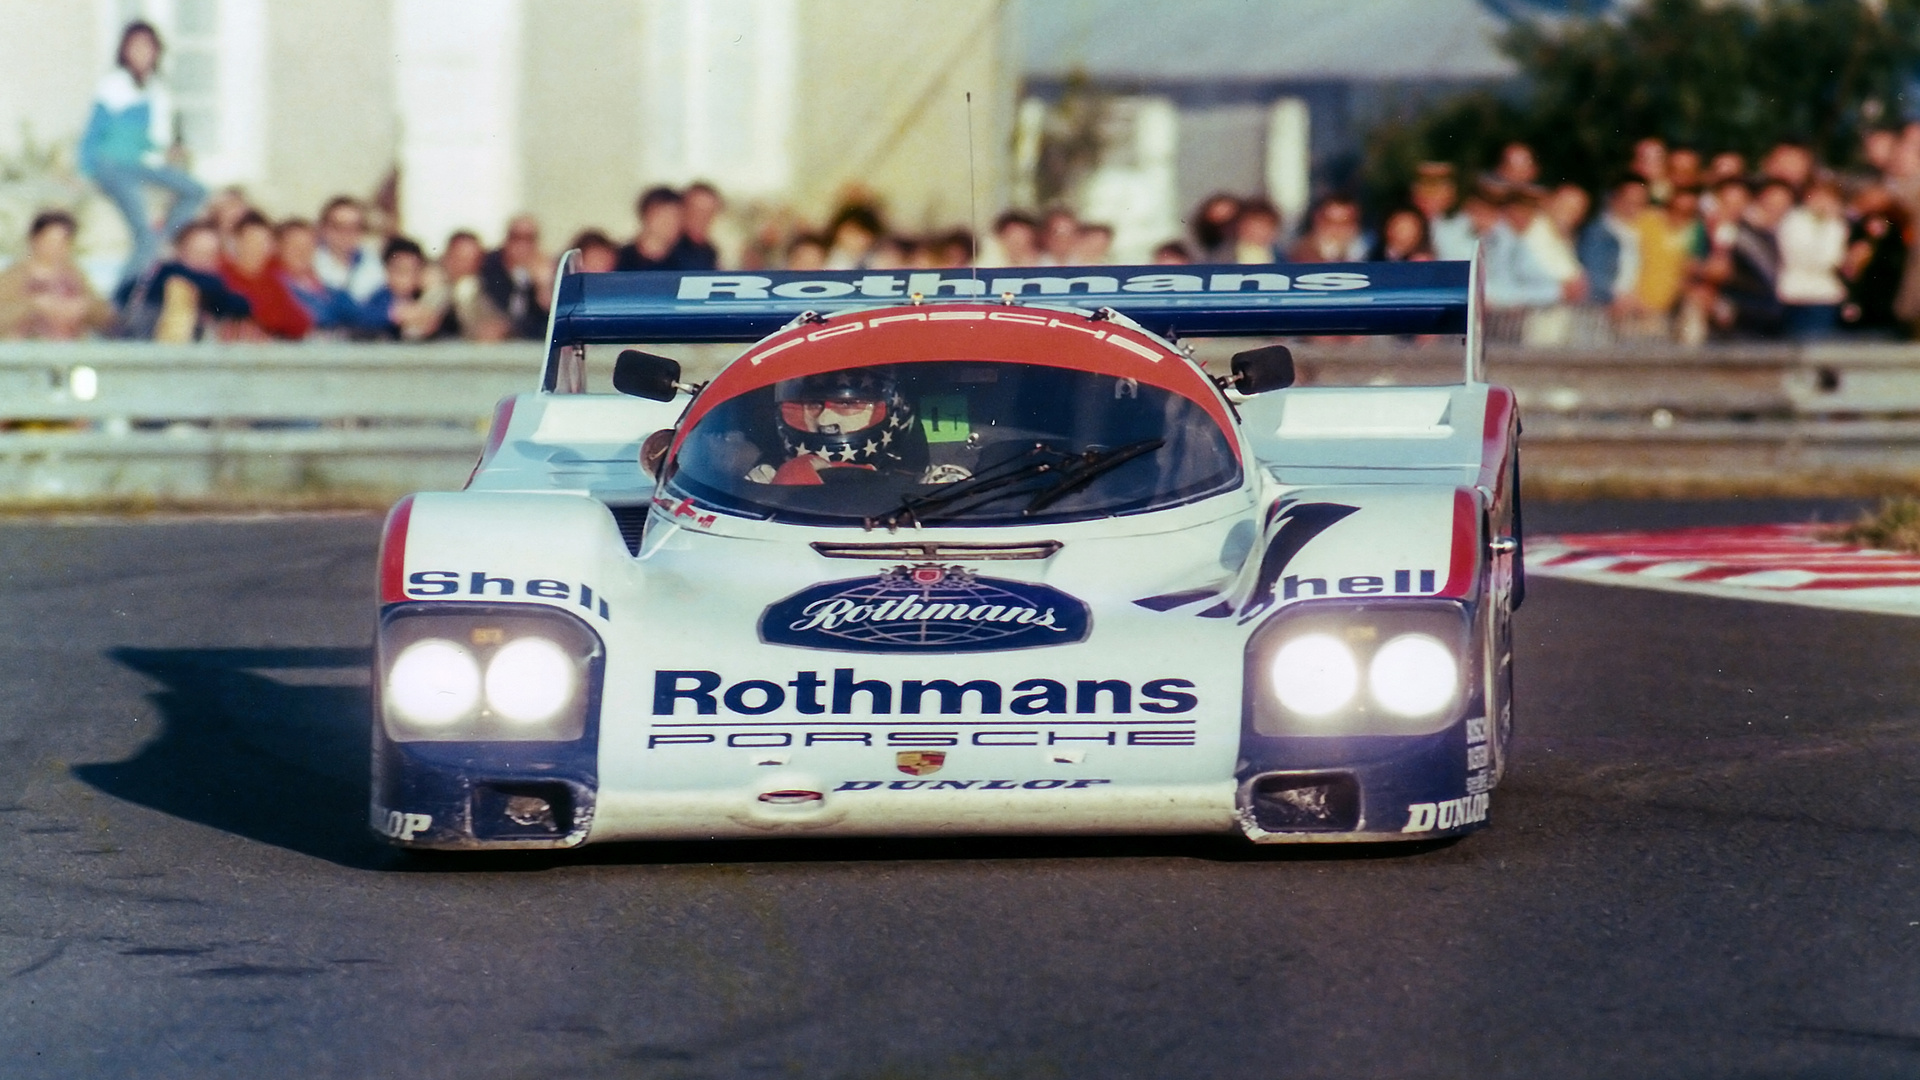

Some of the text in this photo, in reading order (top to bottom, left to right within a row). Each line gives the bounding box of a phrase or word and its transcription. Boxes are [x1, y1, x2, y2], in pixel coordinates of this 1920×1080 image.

[676, 271, 1371, 300] Rothmans
[750, 311, 1164, 366] PORSCHE
[408, 571, 610, 622] Shell
[788, 594, 1067, 632] Rothmans
[651, 668, 1199, 716] Rothmans
[647, 730, 1197, 750] PORSCHE
[833, 780, 1112, 793] DUNLOP
[1402, 793, 1490, 834] DUNLOP
